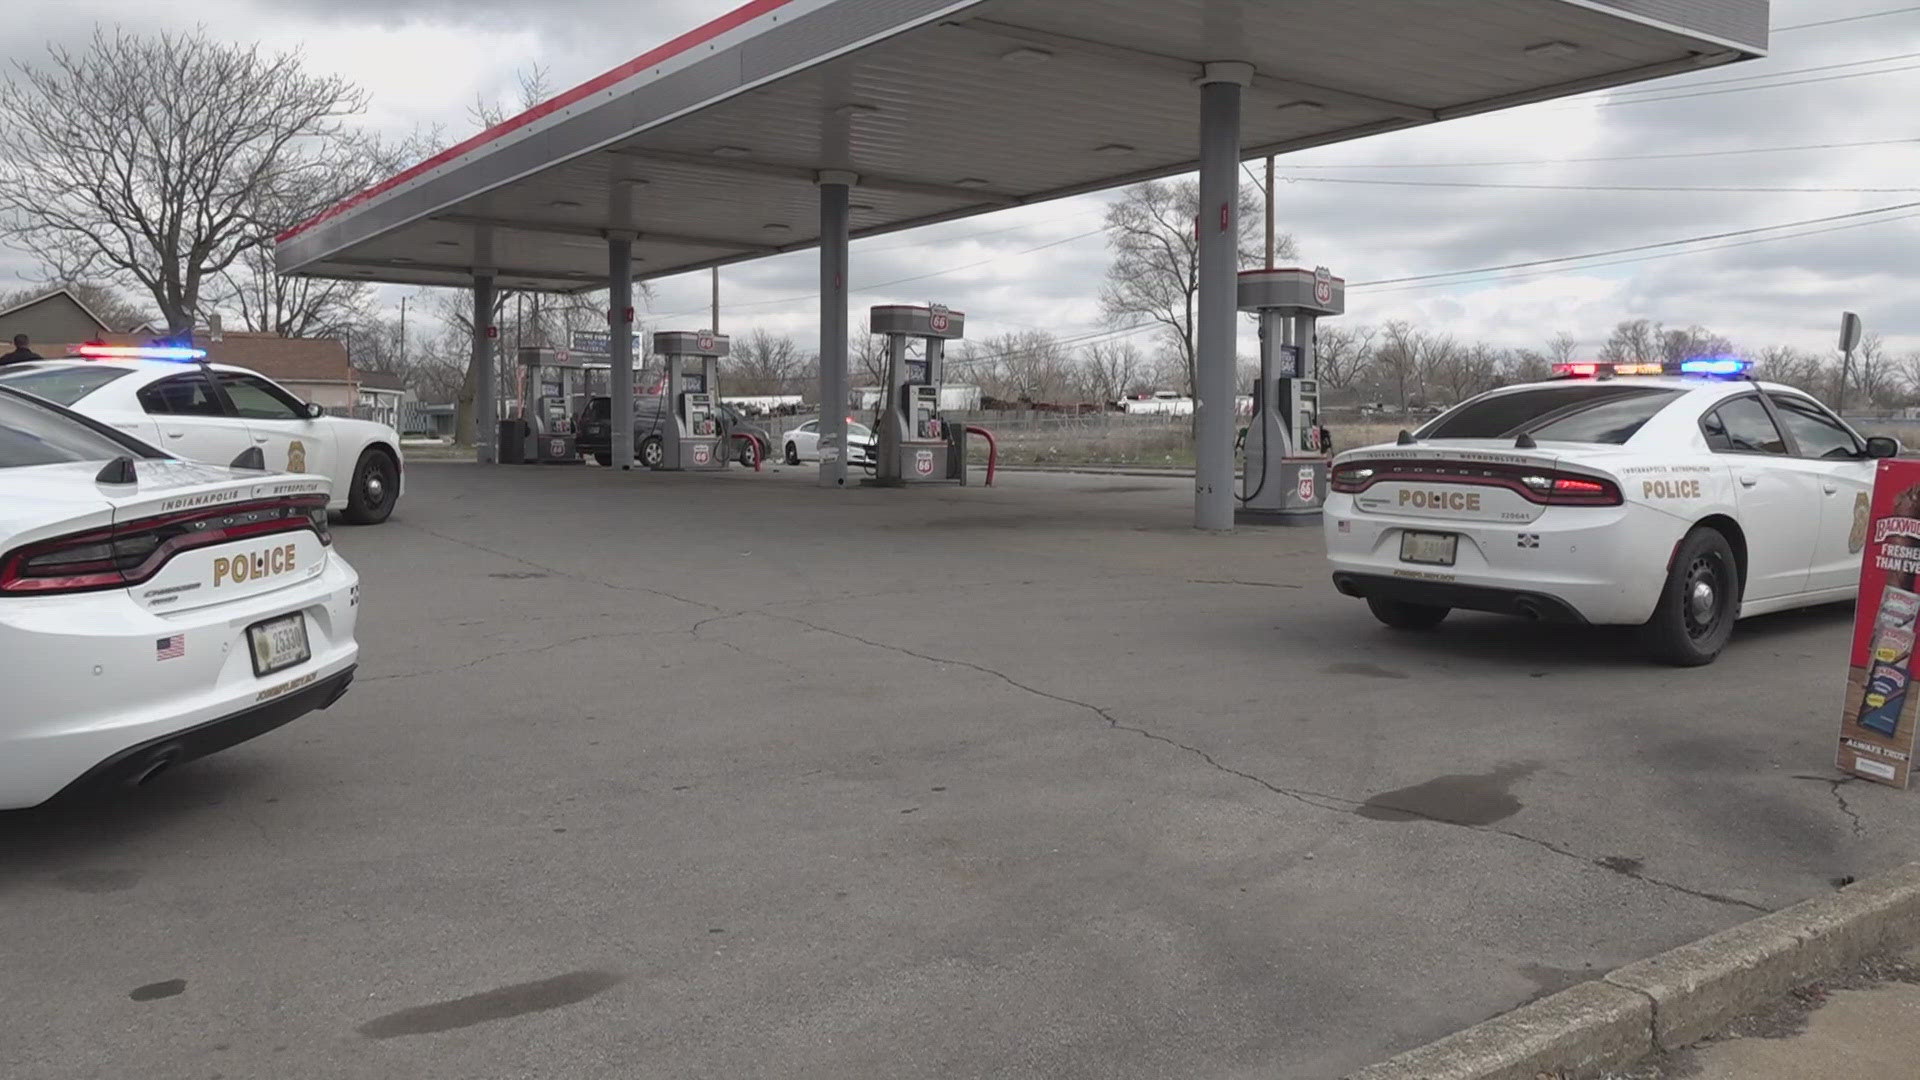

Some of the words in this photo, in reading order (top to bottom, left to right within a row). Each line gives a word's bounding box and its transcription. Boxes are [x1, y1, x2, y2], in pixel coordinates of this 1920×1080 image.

[1318, 281, 1329, 299] 66
[933, 314, 946, 328] 66
[699, 338, 712, 348] 66
[695, 451, 707, 461] 66
[918, 459, 931, 471] 66
[1299, 480, 1311, 496] 66
[1642, 480, 1702, 500] POLICE
[160, 489, 240, 512] INDIANAPOLIS
[1398, 488, 1481, 512] POLICE
[213, 542, 297, 588] POLICE
[1875, 556, 1902, 572] THAN
